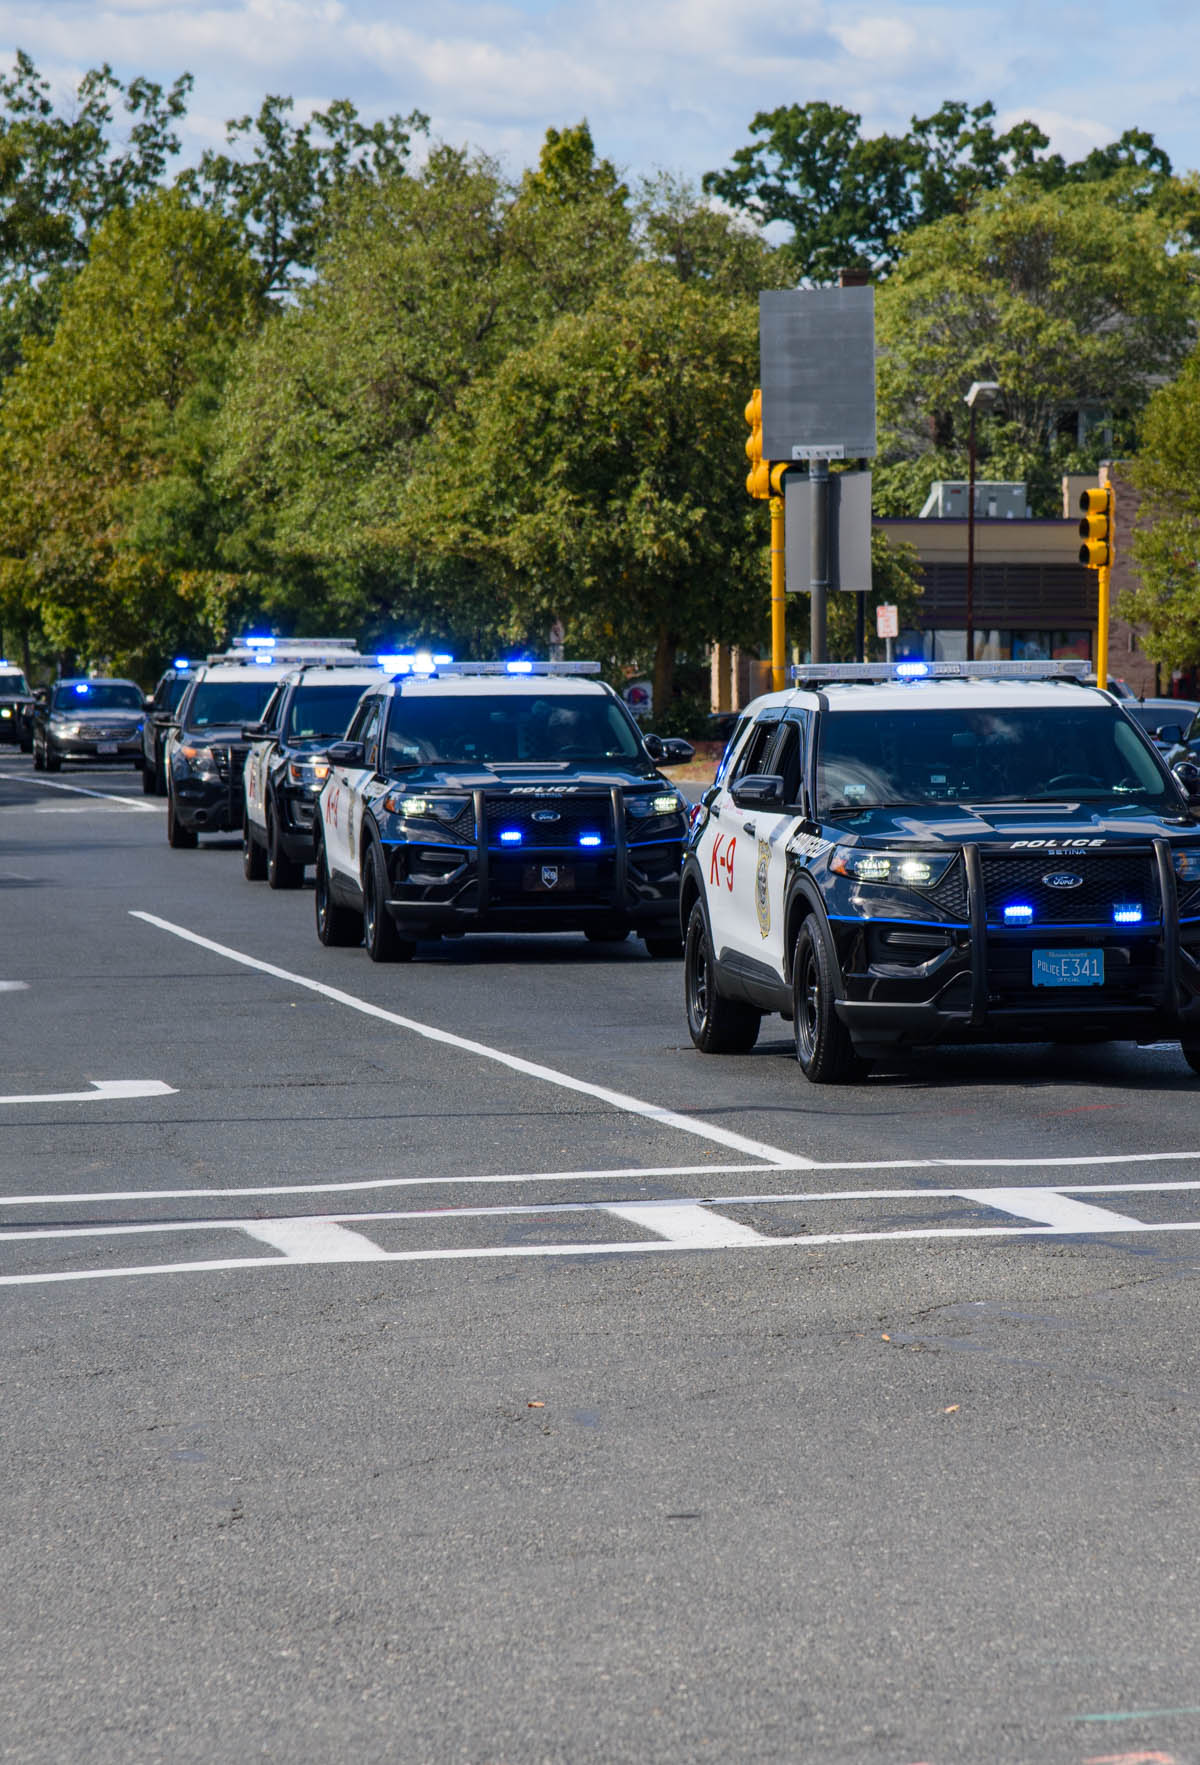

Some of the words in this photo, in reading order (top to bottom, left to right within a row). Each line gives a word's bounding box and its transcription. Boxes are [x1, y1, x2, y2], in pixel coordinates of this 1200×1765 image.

[510, 786, 579, 794] POLICE
[1010, 838, 1107, 849] POLICE
[1047, 848, 1087, 856] SETINA
[710, 832, 737, 892] K-9
[1051, 875, 1075, 886] Ford
[1037, 959, 1060, 977] POLICE
[1061, 958, 1100, 977] E341
